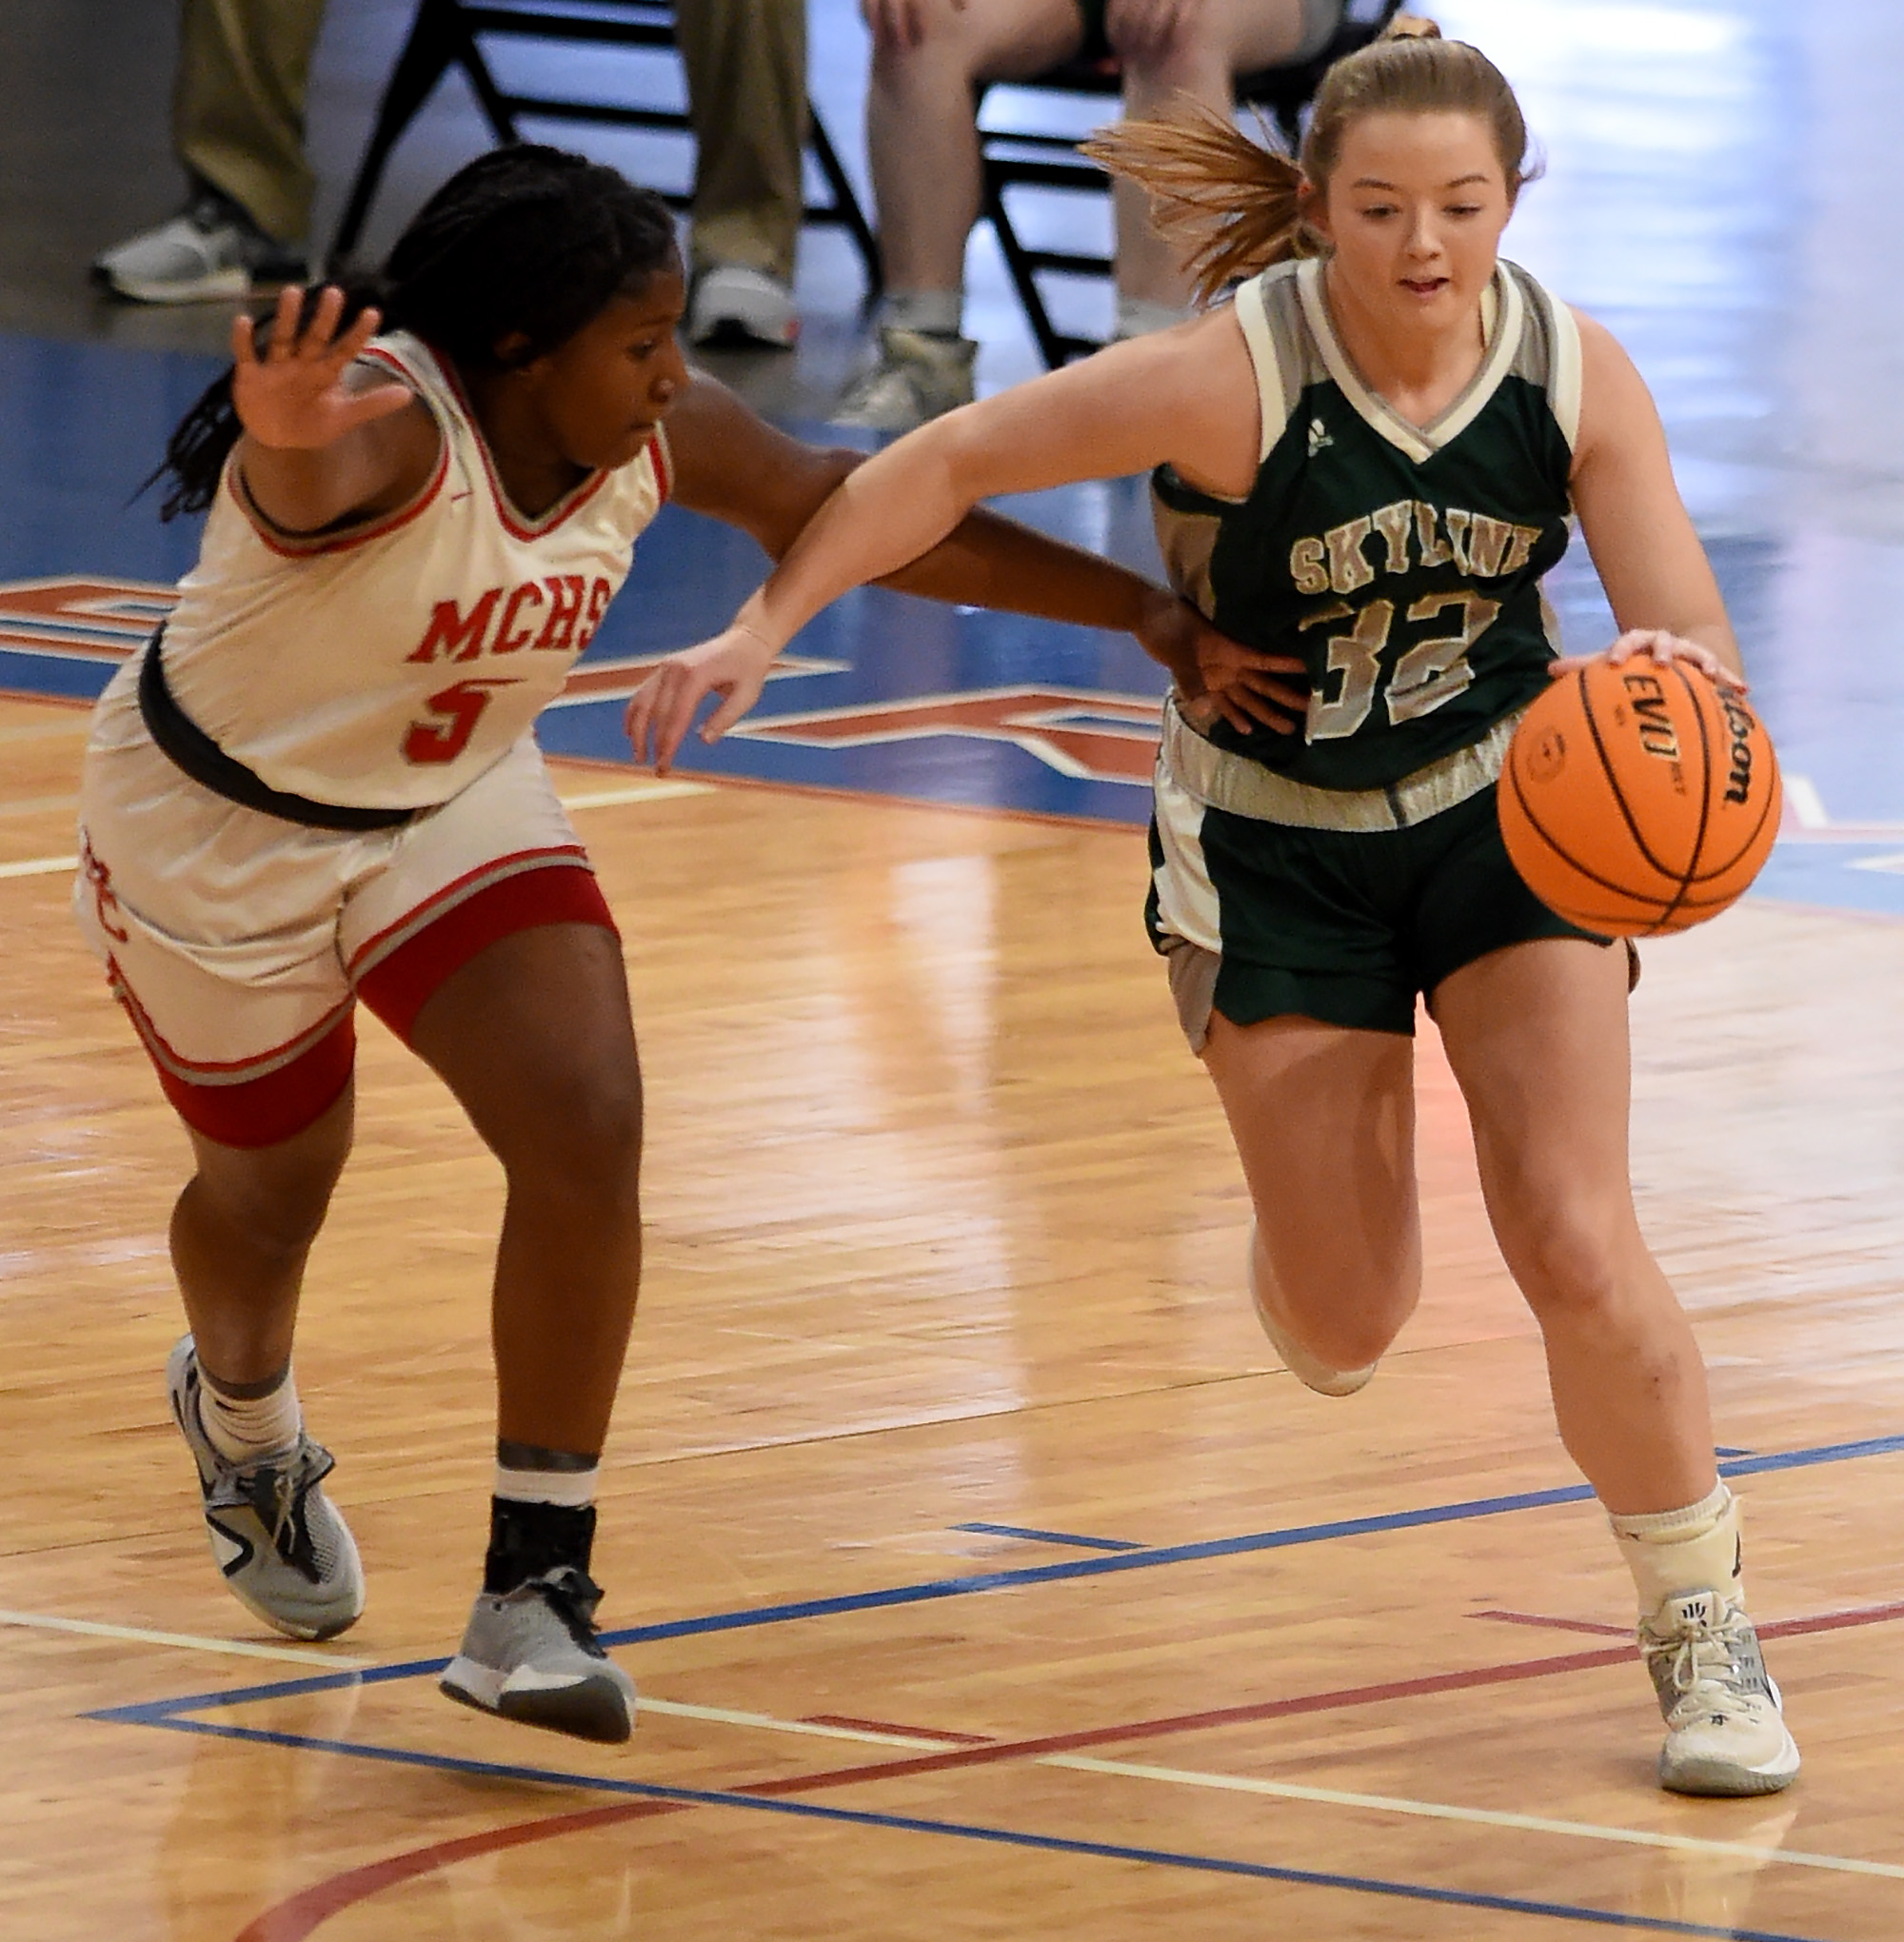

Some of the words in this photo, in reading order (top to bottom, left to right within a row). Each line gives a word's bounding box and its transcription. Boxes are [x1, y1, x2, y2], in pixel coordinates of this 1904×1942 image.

[1290, 499, 1543, 595] SKYLINE
[403, 574, 610, 664] MCHS
[1299, 590, 1502, 745] 32
[401, 678, 526, 767] 5
